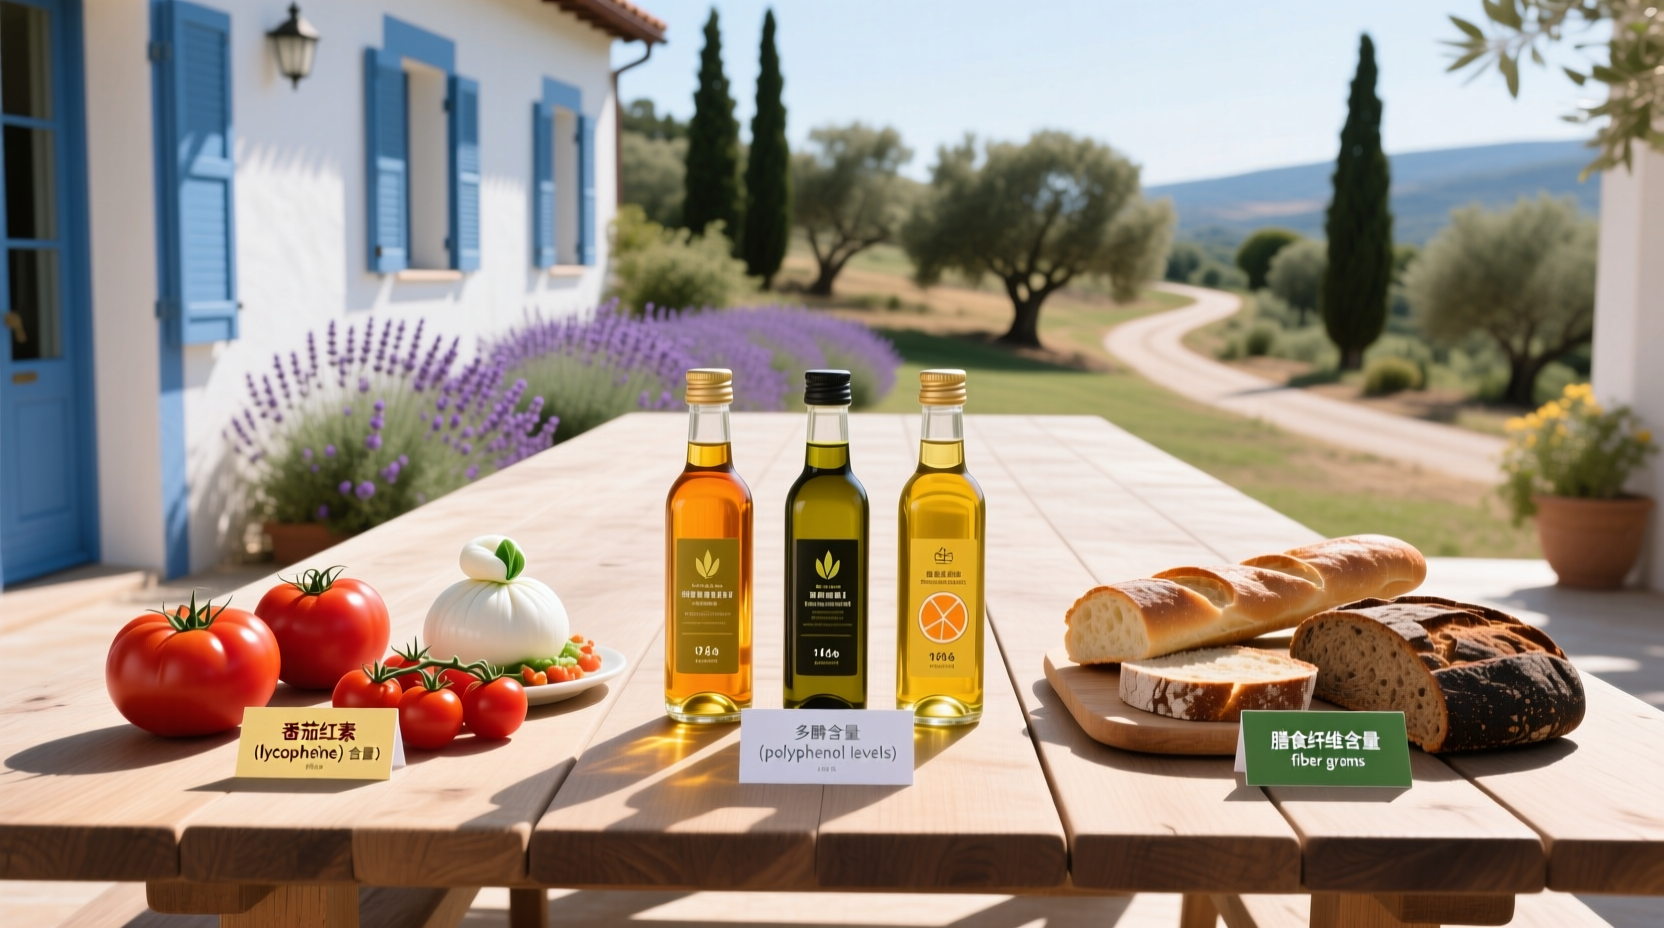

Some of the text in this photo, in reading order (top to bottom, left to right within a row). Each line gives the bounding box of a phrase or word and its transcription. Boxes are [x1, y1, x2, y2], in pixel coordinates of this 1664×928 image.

[282, 721, 356, 742] 番茄红素
[759, 744, 897, 763] (polyphenol levels)
[1291, 752, 1322, 767] fiber
